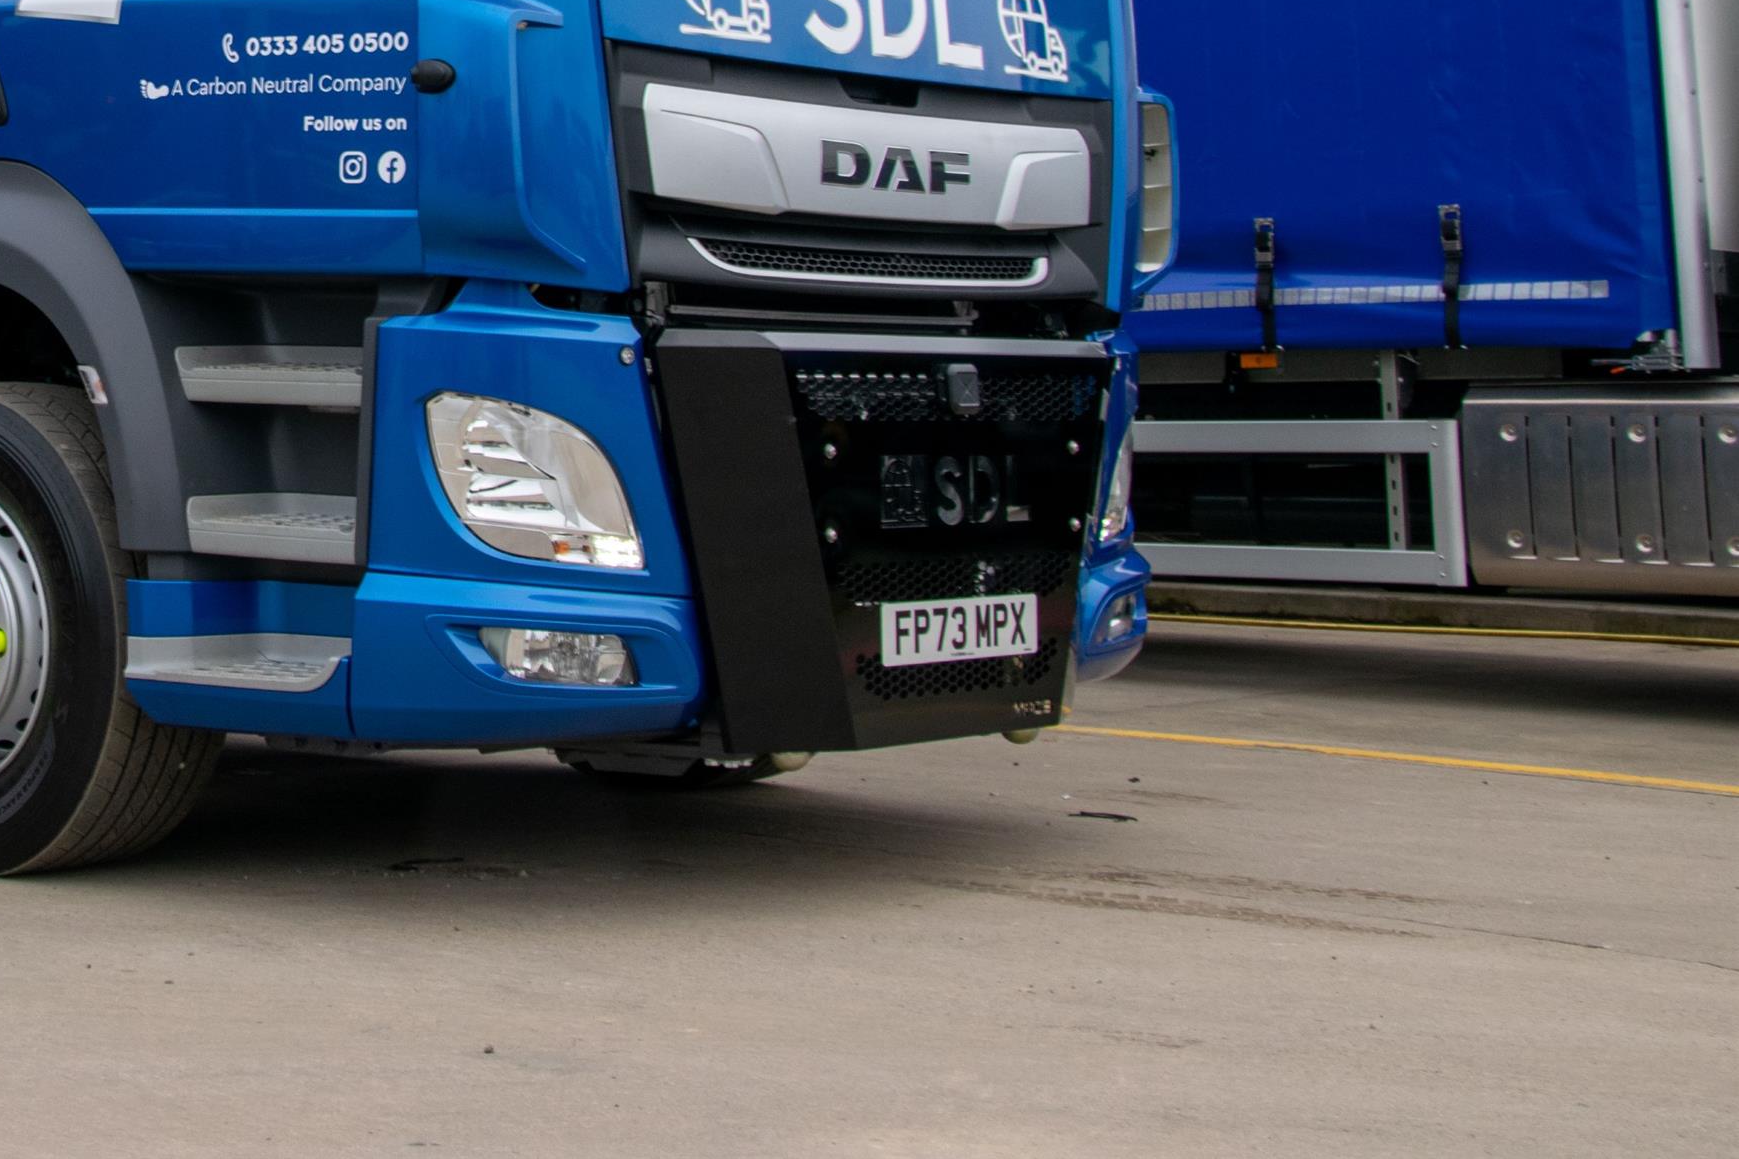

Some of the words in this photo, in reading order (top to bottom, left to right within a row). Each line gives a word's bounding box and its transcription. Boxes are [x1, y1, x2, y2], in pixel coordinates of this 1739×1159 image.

[246, 35, 298, 57] 0333
[302, 34, 344, 54] 405
[349, 31, 409, 53] 0500
[171, 80, 184, 96] A
[186, 77, 247, 96] Carbon
[251, 74, 313, 94] Neutral
[318, 74, 407, 95] Company
[303, 116, 359, 131] Follow
[362, 119, 382, 131] us
[385, 118, 407, 131] on
[820, 138, 971, 195] DAF
[935, 455, 1031, 526] SDL
[895, 606, 967, 655] FP73
[976, 602, 1026, 648] MPX
